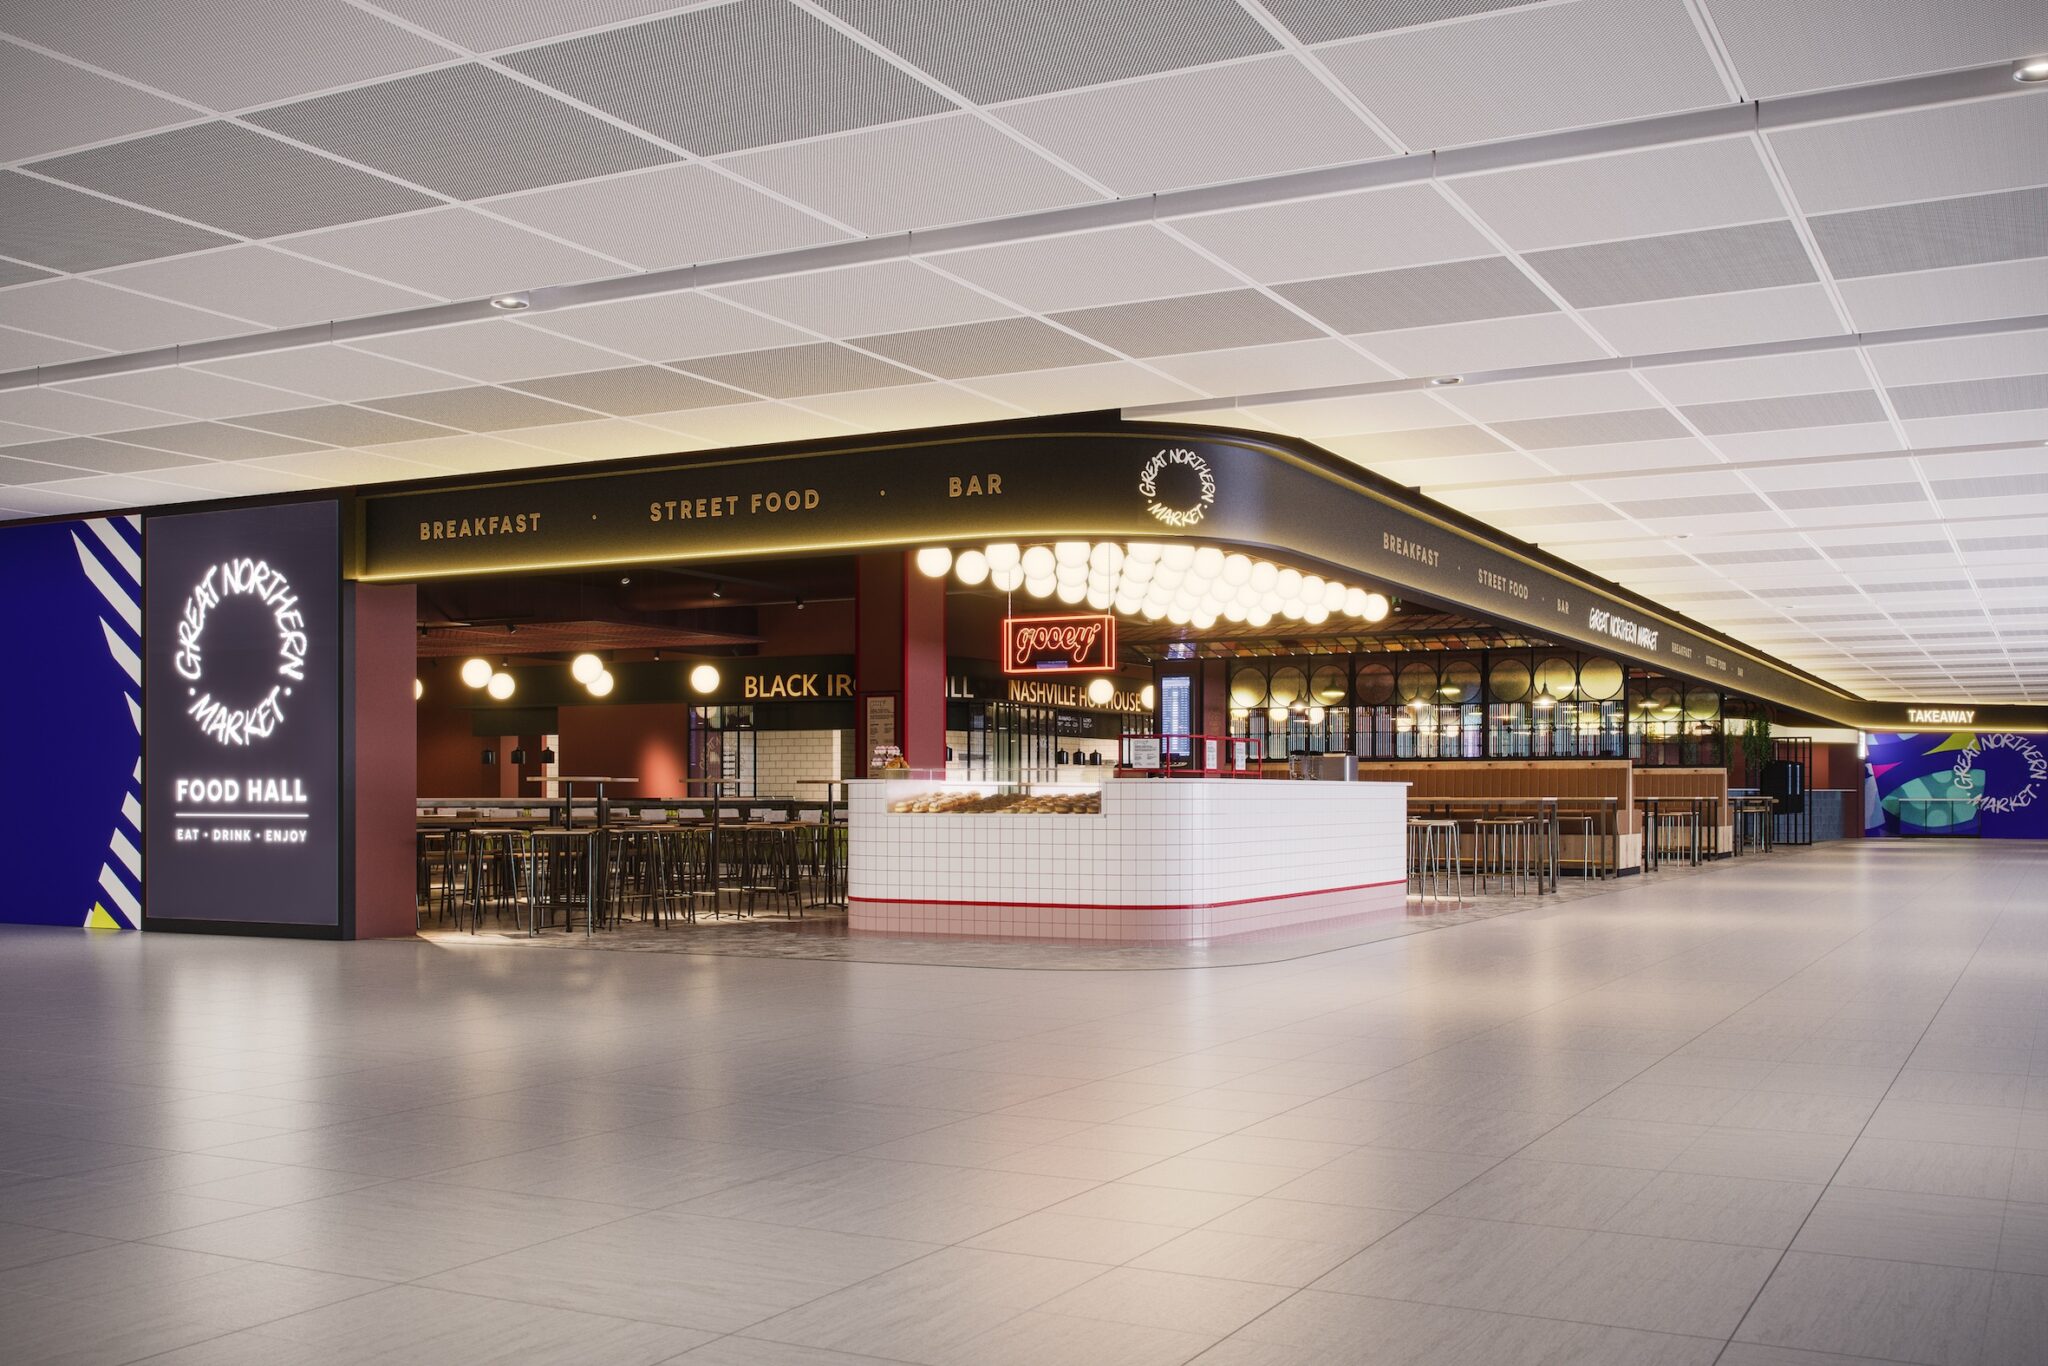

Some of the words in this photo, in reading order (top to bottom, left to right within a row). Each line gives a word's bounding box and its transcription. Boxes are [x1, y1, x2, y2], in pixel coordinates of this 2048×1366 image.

[1139, 449, 1167, 497] GREAT
[1169, 448, 1216, 503] NORTHERN
[419, 513, 541, 541] BREAKFAST
[650, 496, 739, 522] STREET
[751, 489, 820, 514] FOOD
[949, 474, 1002, 497] BAR
[1147, 502, 1204, 527] MARKET
[1383, 532, 1439, 567] BREAKFAST
[1478, 568, 1507, 592] STREET
[1509, 580, 1529, 600] FOOD
[1557, 598, 1570, 615] BAR
[176, 564, 219, 680] GREAT
[222, 558, 307, 680] NORTHERN
[1589, 607, 1610, 634] GREAT
[1016, 622, 1102, 663] gooey
[744, 674, 818, 698] BLACK
[828, 674, 856, 697] IR
[1010, 680, 1076, 706] NASHVILLE
[188, 685, 284, 745] MARKET
[1908, 709, 1975, 724] TAKEAWAY
[1953, 739, 1982, 790] GREAT
[1981, 732, 2048, 780] NORTHERN
[176, 778, 240, 802] FOOD
[247, 778, 308, 803] HALL
[1968, 783, 2039, 814] MARKET
[176, 828, 200, 842] EAT
[212, 828, 251, 842] DRINK
[264, 829, 307, 842] ENJOY
